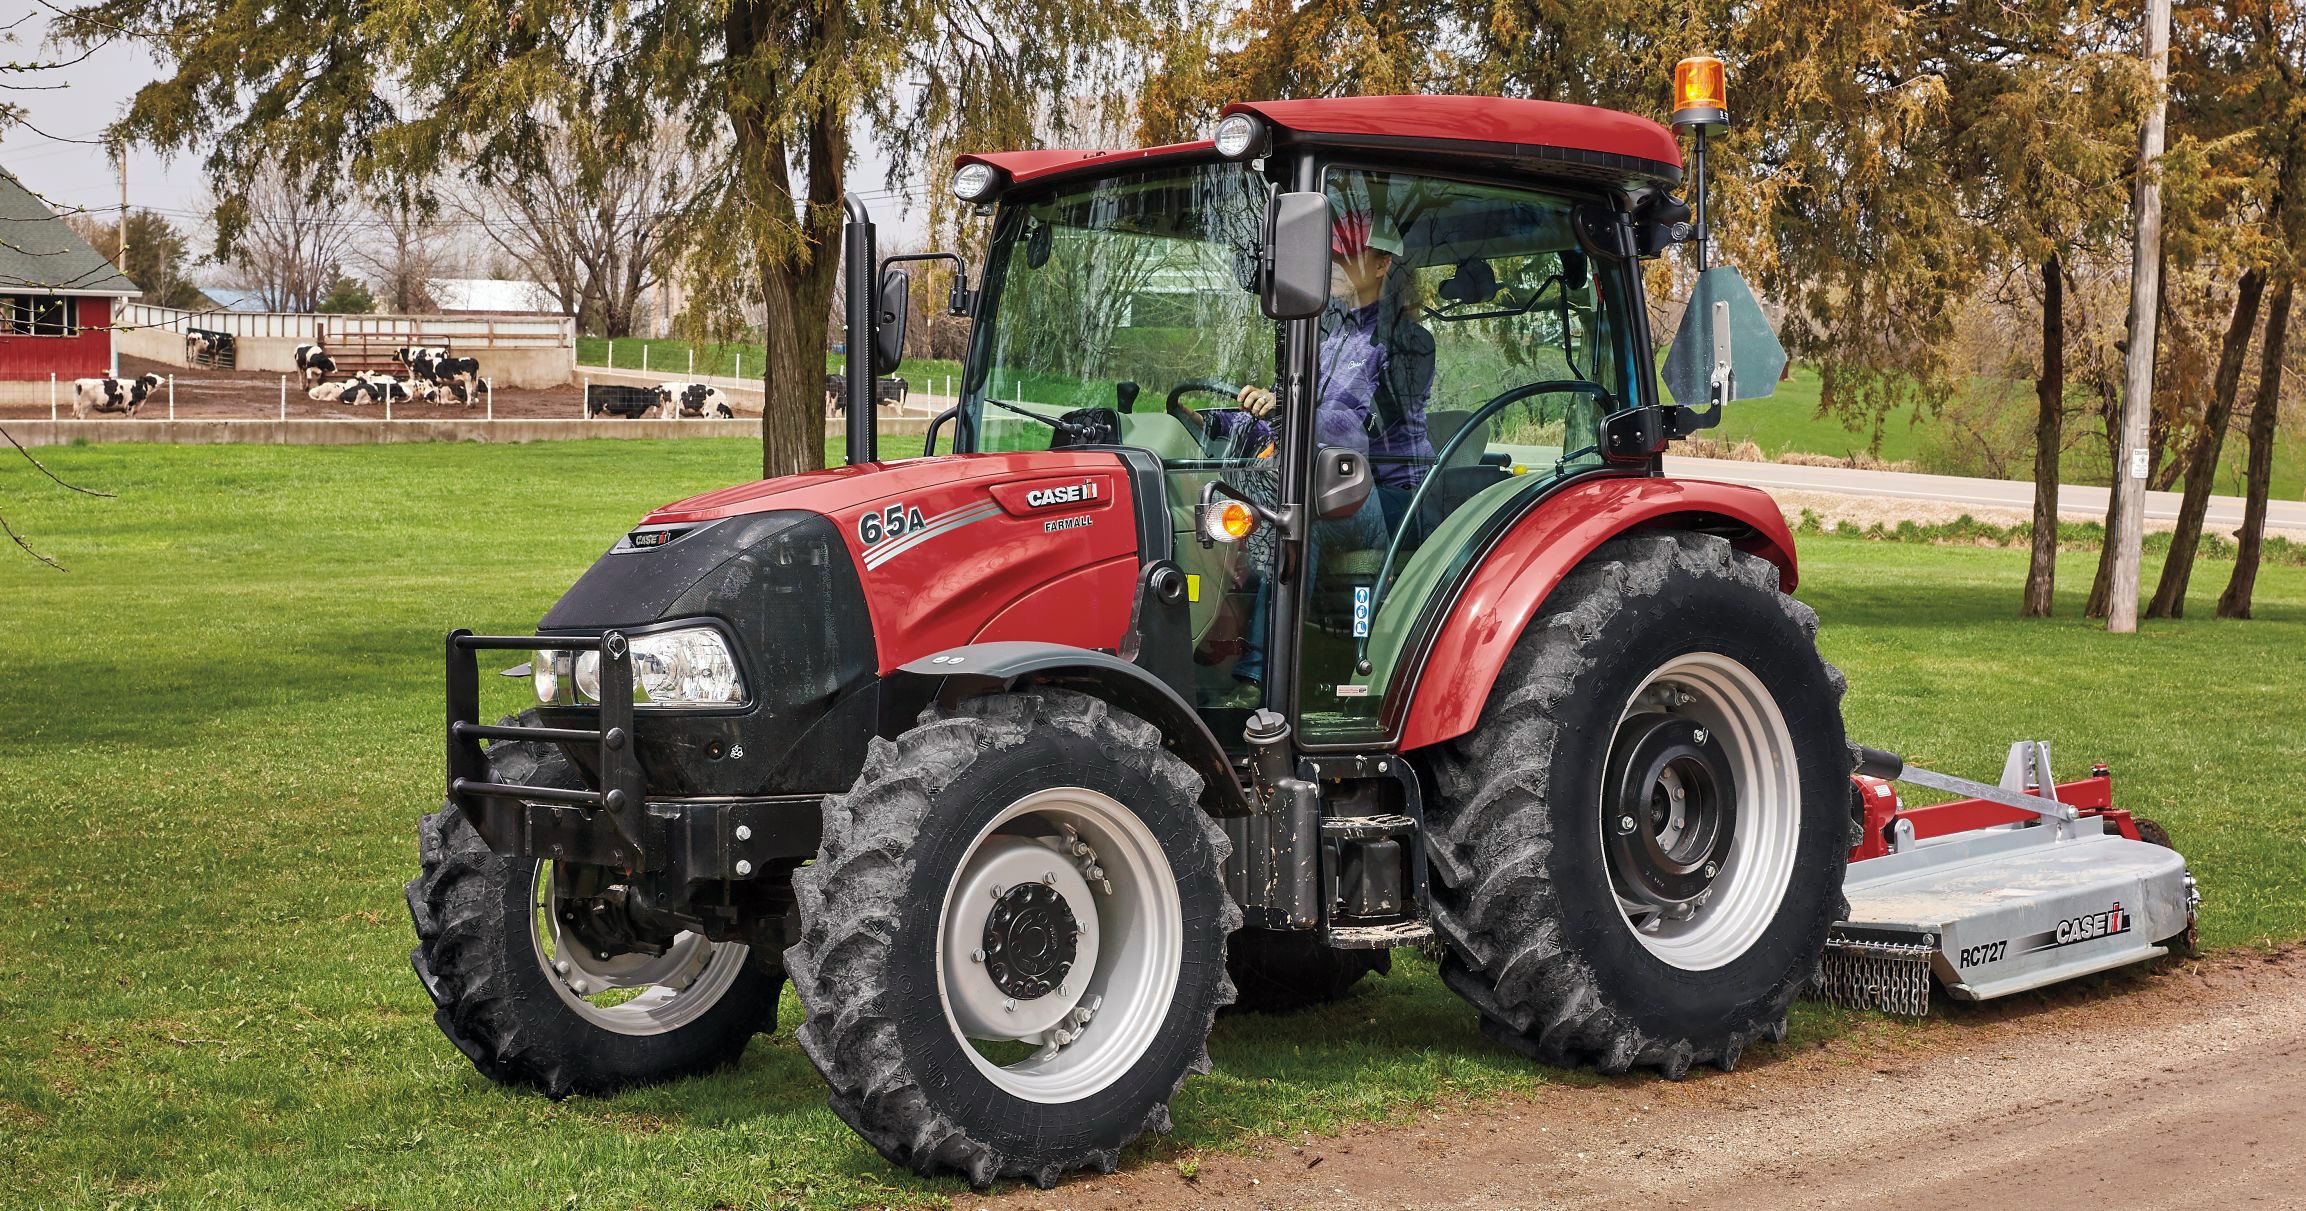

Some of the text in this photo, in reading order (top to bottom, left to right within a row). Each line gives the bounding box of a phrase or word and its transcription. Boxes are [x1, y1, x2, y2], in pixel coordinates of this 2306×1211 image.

[1027, 485, 1079, 508] CASE
[860, 503, 927, 545] 65A
[1044, 515, 1093, 533] FARMALL
[636, 534, 657, 545] CASE
[2057, 913, 2106, 944] CASE
[1959, 940, 2008, 969] RC727
